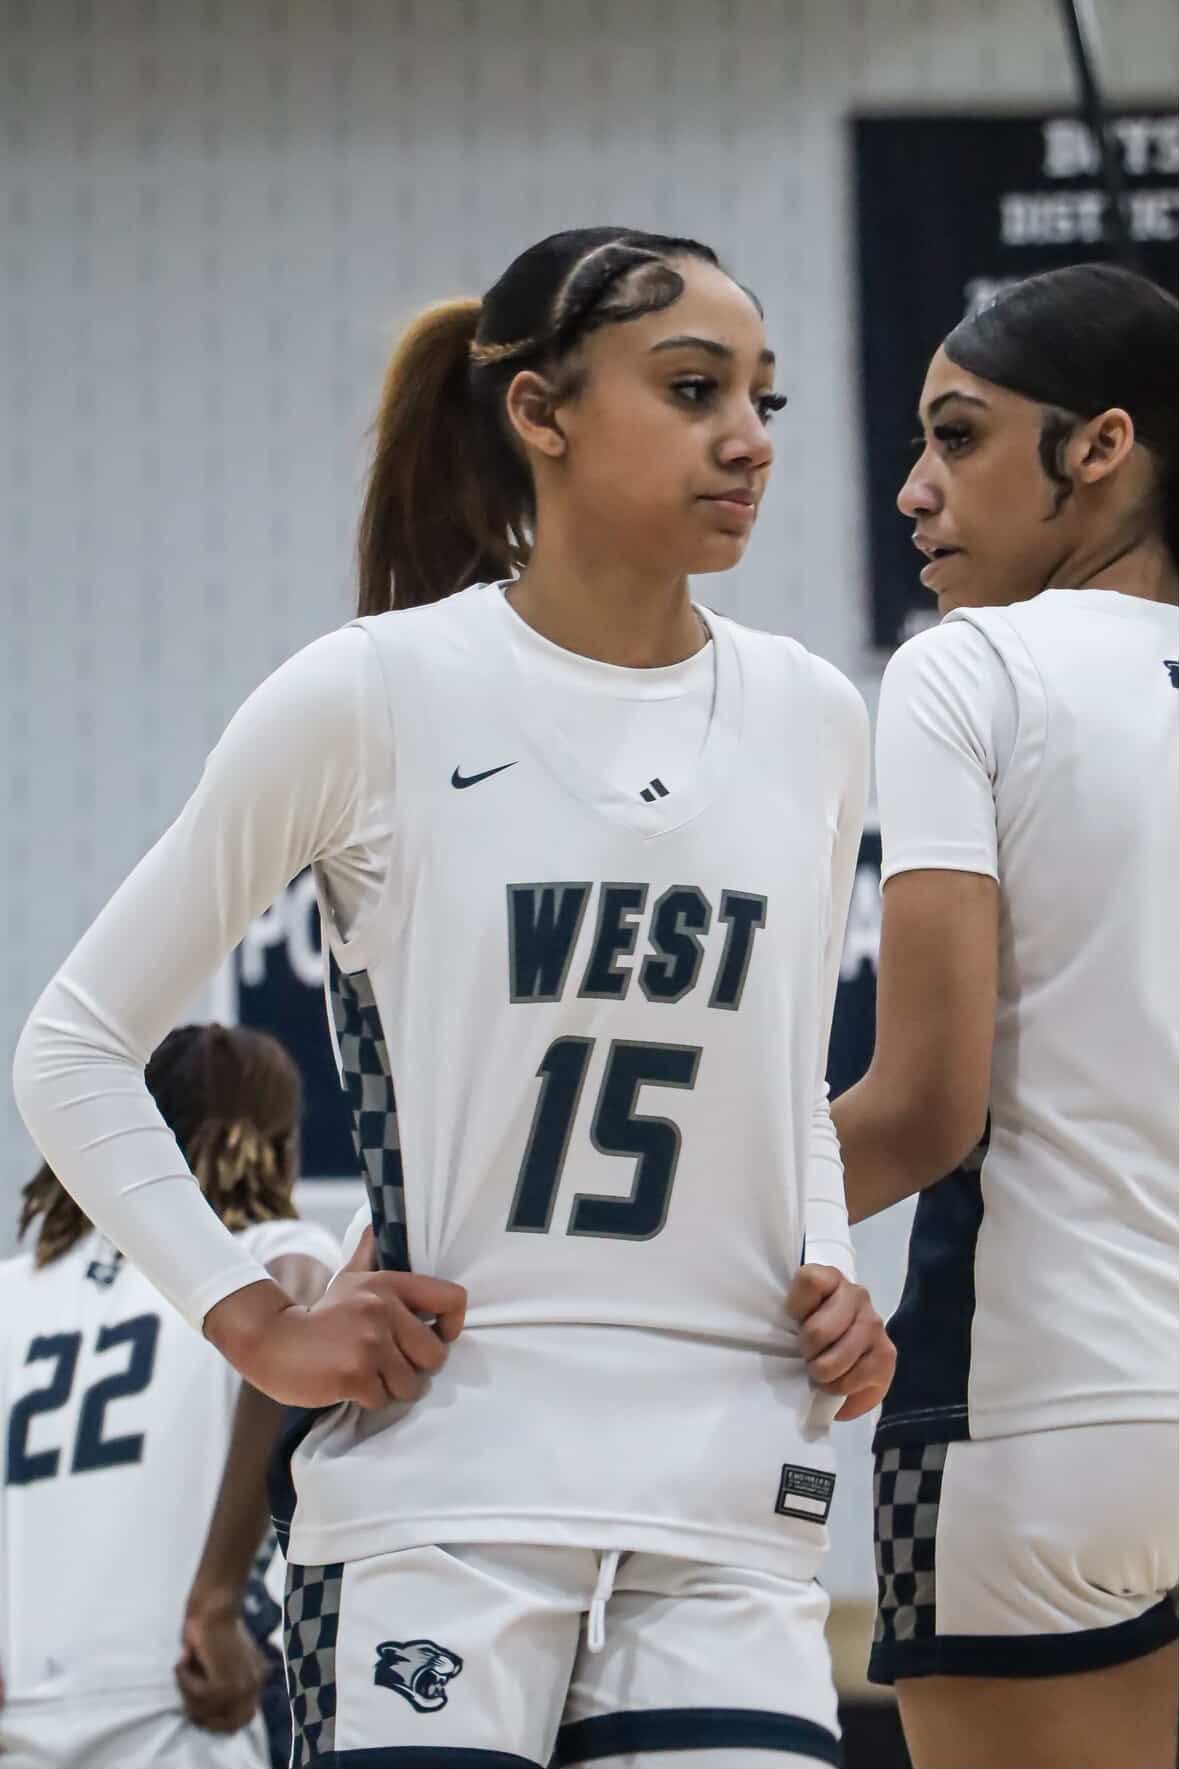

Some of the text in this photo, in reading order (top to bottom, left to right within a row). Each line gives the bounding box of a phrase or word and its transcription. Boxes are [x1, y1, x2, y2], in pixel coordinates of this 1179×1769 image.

[506, 882, 768, 1011] WEST
[505, 1035, 704, 1241] 15
[5, 1313, 161, 1486] 22
